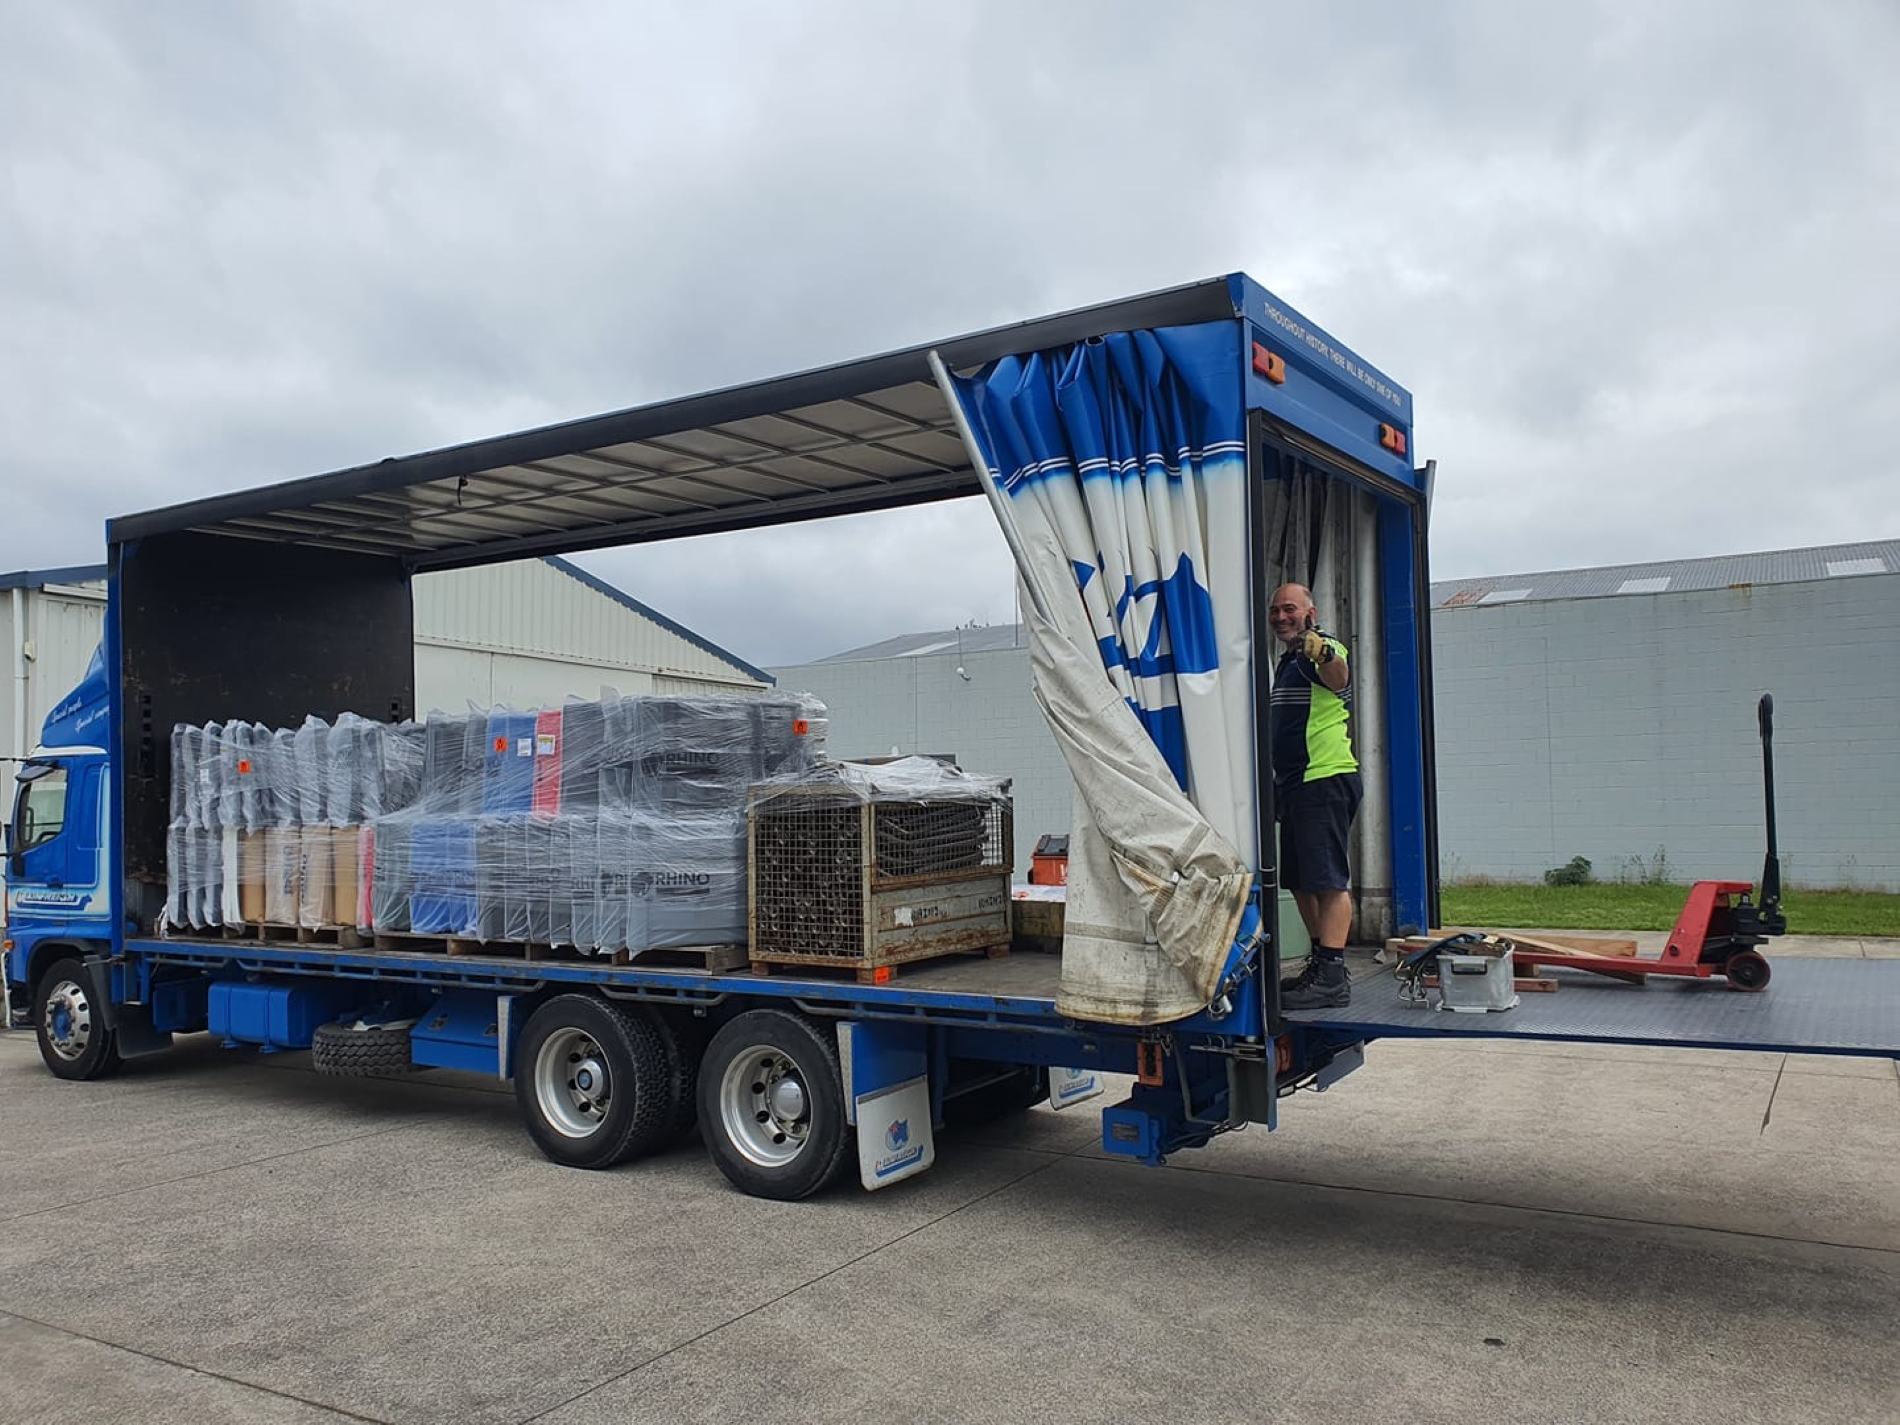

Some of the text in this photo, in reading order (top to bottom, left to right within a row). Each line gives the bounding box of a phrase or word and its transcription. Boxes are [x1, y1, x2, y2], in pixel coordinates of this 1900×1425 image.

[1264, 302, 1306, 340] THROUGHOUT
[1329, 347, 1345, 369] THERE
[1346, 359, 1357, 377] WILL
[666, 752, 719, 765] RHINO
[655, 872, 711, 886] RHINO
